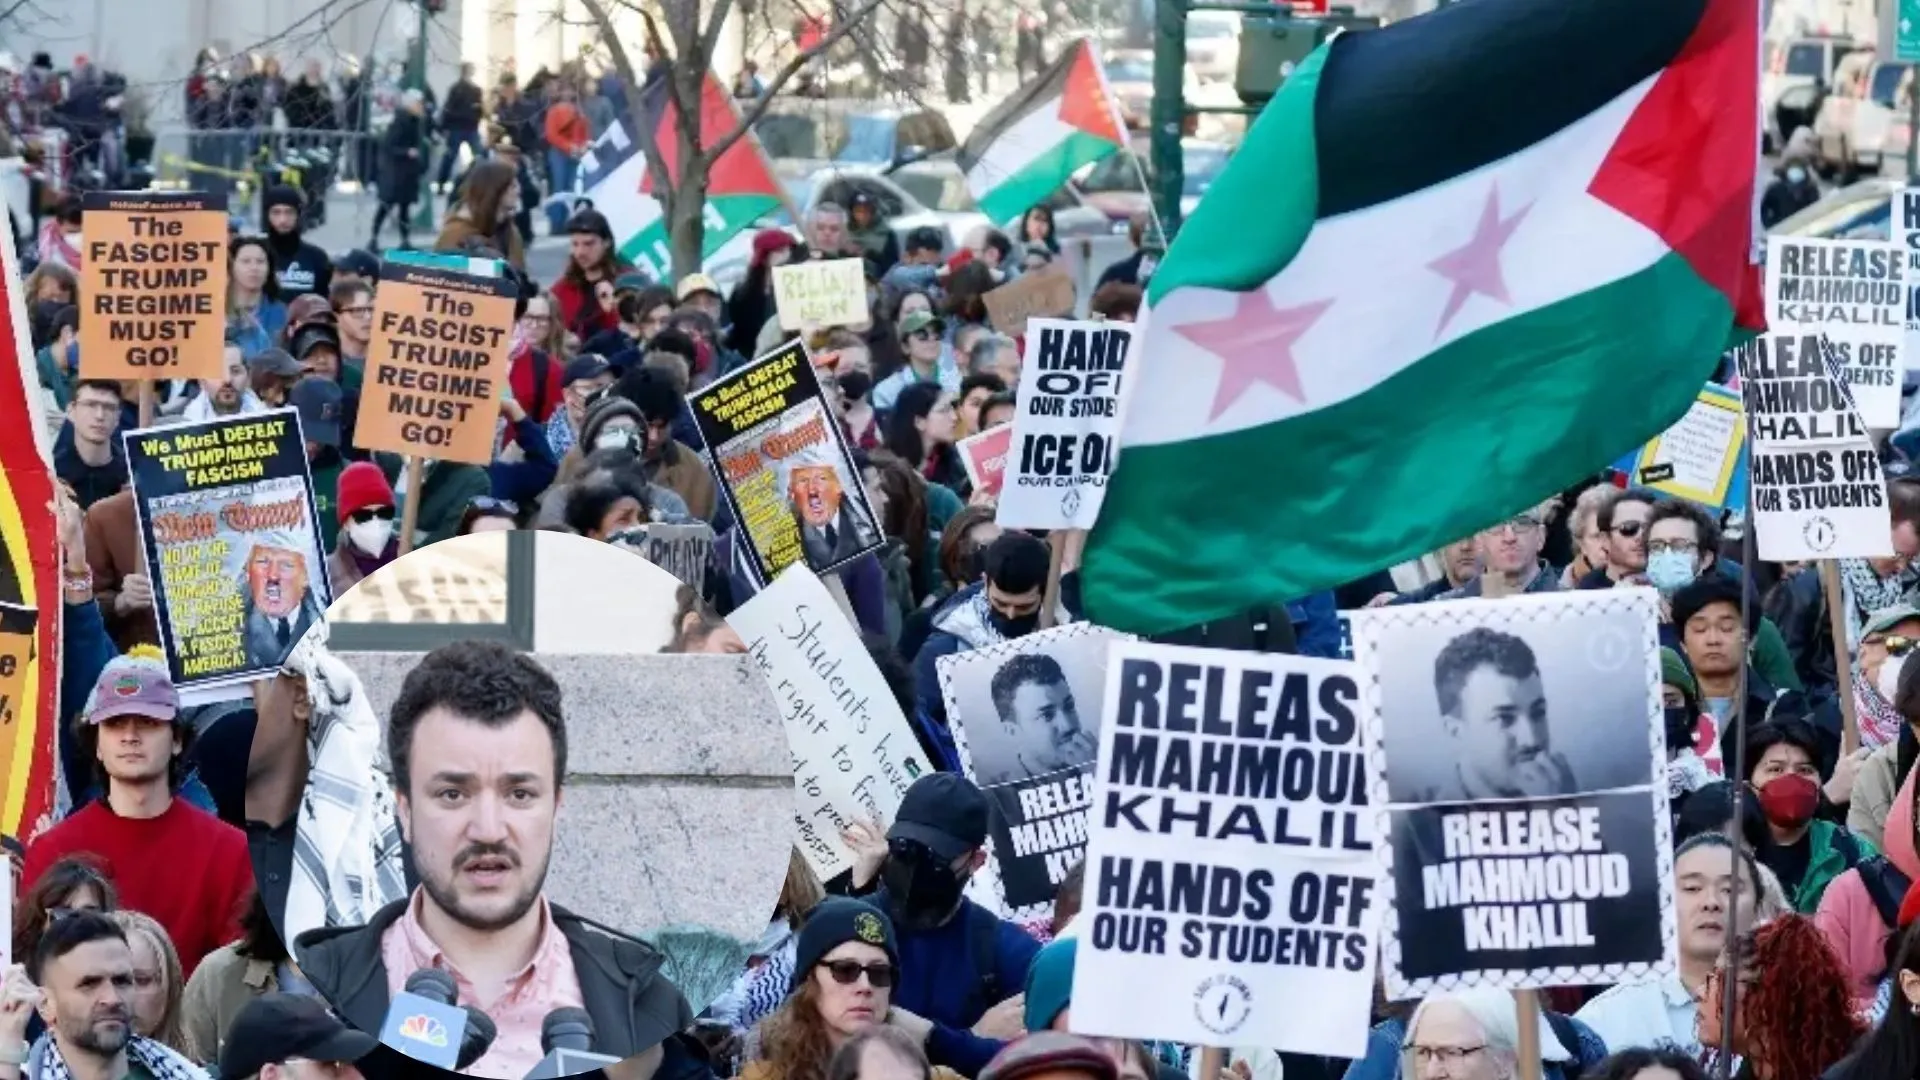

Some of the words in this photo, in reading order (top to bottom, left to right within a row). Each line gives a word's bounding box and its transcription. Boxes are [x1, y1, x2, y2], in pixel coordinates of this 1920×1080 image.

[128, 217, 183, 236] The
[90, 242, 220, 262] FASCIST
[1780, 244, 1903, 280] RELEASE
[99, 268, 207, 289] TRUMP
[1778, 277, 1902, 305] MAHMOUD
[94, 294, 212, 315] REGIME
[422, 291, 474, 317] The
[1778, 303, 1900, 325] KHALIL
[110, 320, 196, 341] MUST
[381, 311, 505, 348] FASCIST
[126, 347, 178, 366] GO!
[388, 339, 490, 372] TRUMP
[747, 352, 798, 387] DEFEAT
[1859, 343, 1896, 367] OFF
[377, 365, 492, 399] REGIME
[388, 393, 473, 422] MUST
[731, 393, 786, 431] FASCISM
[1029, 396, 1064, 417] OUR
[1070, 397, 1118, 418] STUDE
[141, 438, 171, 456] We
[175, 432, 220, 450] Must
[224, 421, 286, 443] DEFEAT
[401, 421, 452, 446] GO!
[1753, 412, 1864, 440] HALIL
[159, 441, 279, 472] TRUMP/MAGA
[1020, 434, 1077, 476] ICE
[1841, 449, 1879, 482] OFF
[186, 461, 263, 487] FASCISM
[1018, 477, 1050, 488] OUR
[1787, 484, 1882, 511] STUDENTS
[196, 612, 245, 635] ACCEPT
[778, 604, 871, 734] Students
[1117, 658, 1362, 747] RELEAS
[778, 679, 829, 736] right
[831, 744, 853, 773] to
[802, 775, 822, 797] to
[1104, 791, 1373, 851] KHALIL
[1441, 807, 1602, 858] RELEASE
[1097, 856, 1275, 921] HANDS
[1289, 871, 1375, 928] OFF
[1422, 852, 1631, 909] MAHMOUD
[1463, 902, 1596, 951] KHALIL
[1092, 912, 1167, 955] OUR
[1180, 919, 1367, 972] STUDENTS
